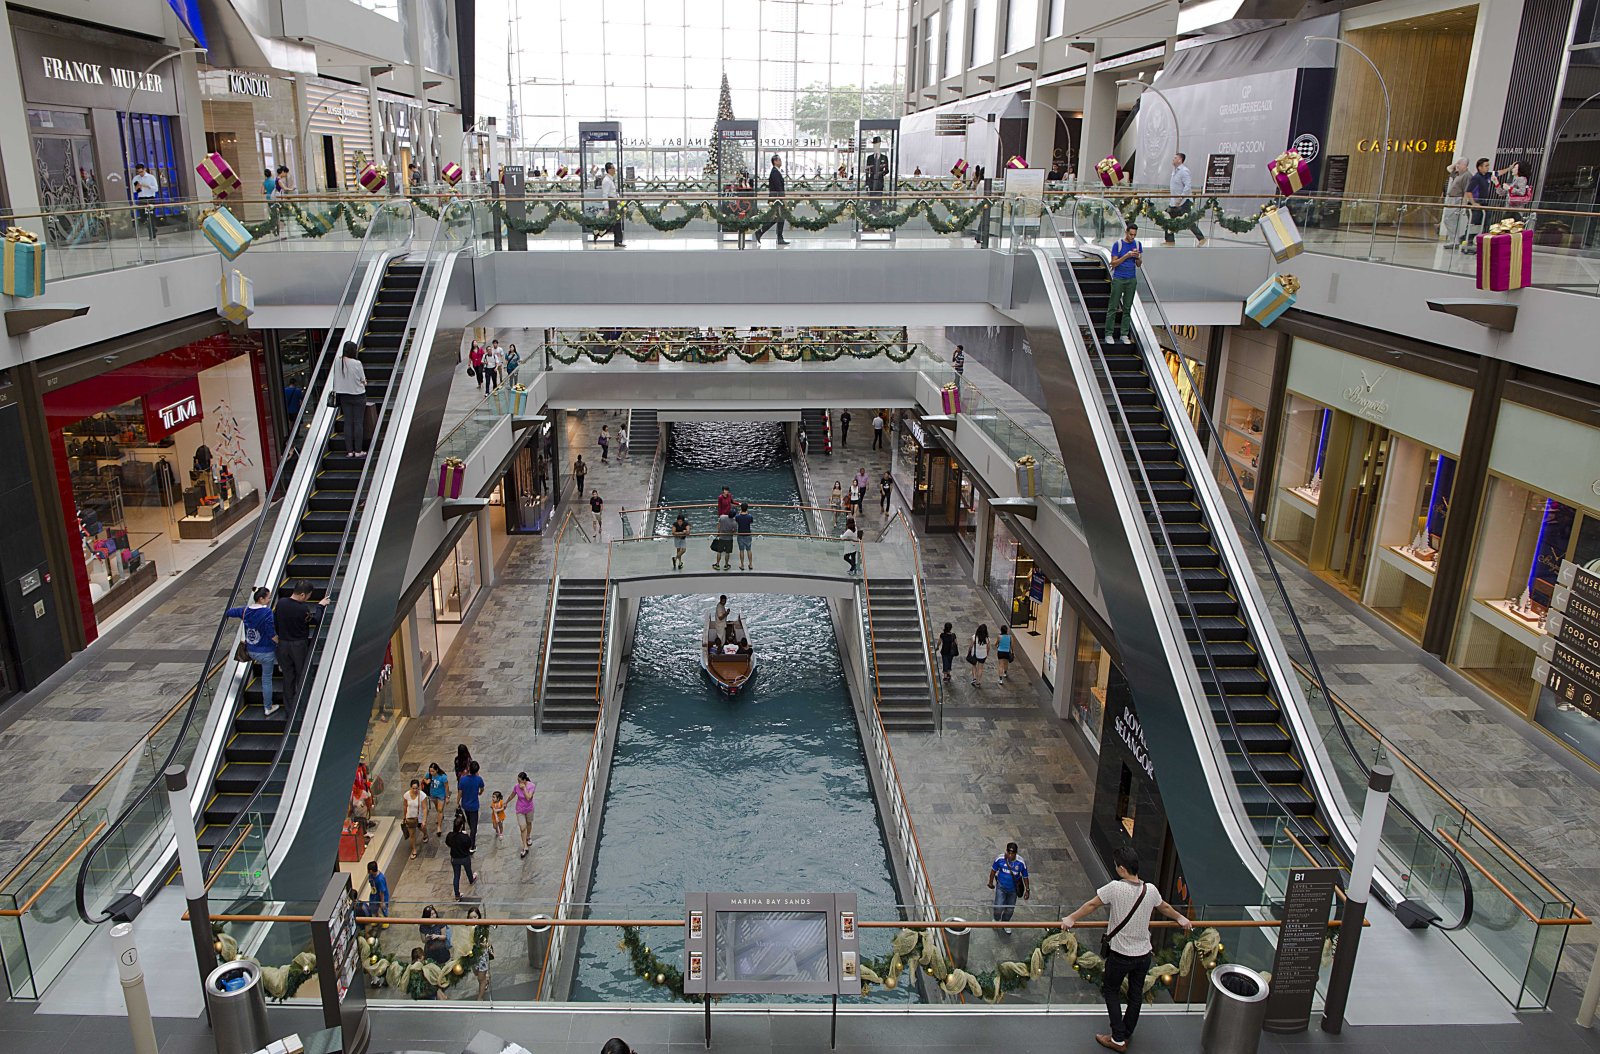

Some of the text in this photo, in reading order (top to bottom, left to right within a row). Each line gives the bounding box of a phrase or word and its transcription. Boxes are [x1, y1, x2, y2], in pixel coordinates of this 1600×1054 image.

[41, 56, 163, 93] FRANCK MULLER
[230, 75, 272, 98] MONDIAL
[1245, 141, 1266, 153] SOON
[1357, 139, 1428, 153] CASINO
[1496, 147, 1545, 155] RICHARD MILLE
[511, 174, 517, 186] 1
[1578, 575, 1600, 592] MUSE
[1571, 599, 1600, 619] CELEBRI
[1564, 624, 1585, 640] FOOD
[1587, 637, 1600, 648] CO
[1124, 706, 1148, 751] ROYAL
[1114, 716, 1154, 780] SELANGOR
[1294, 873, 1305, 881] B1
